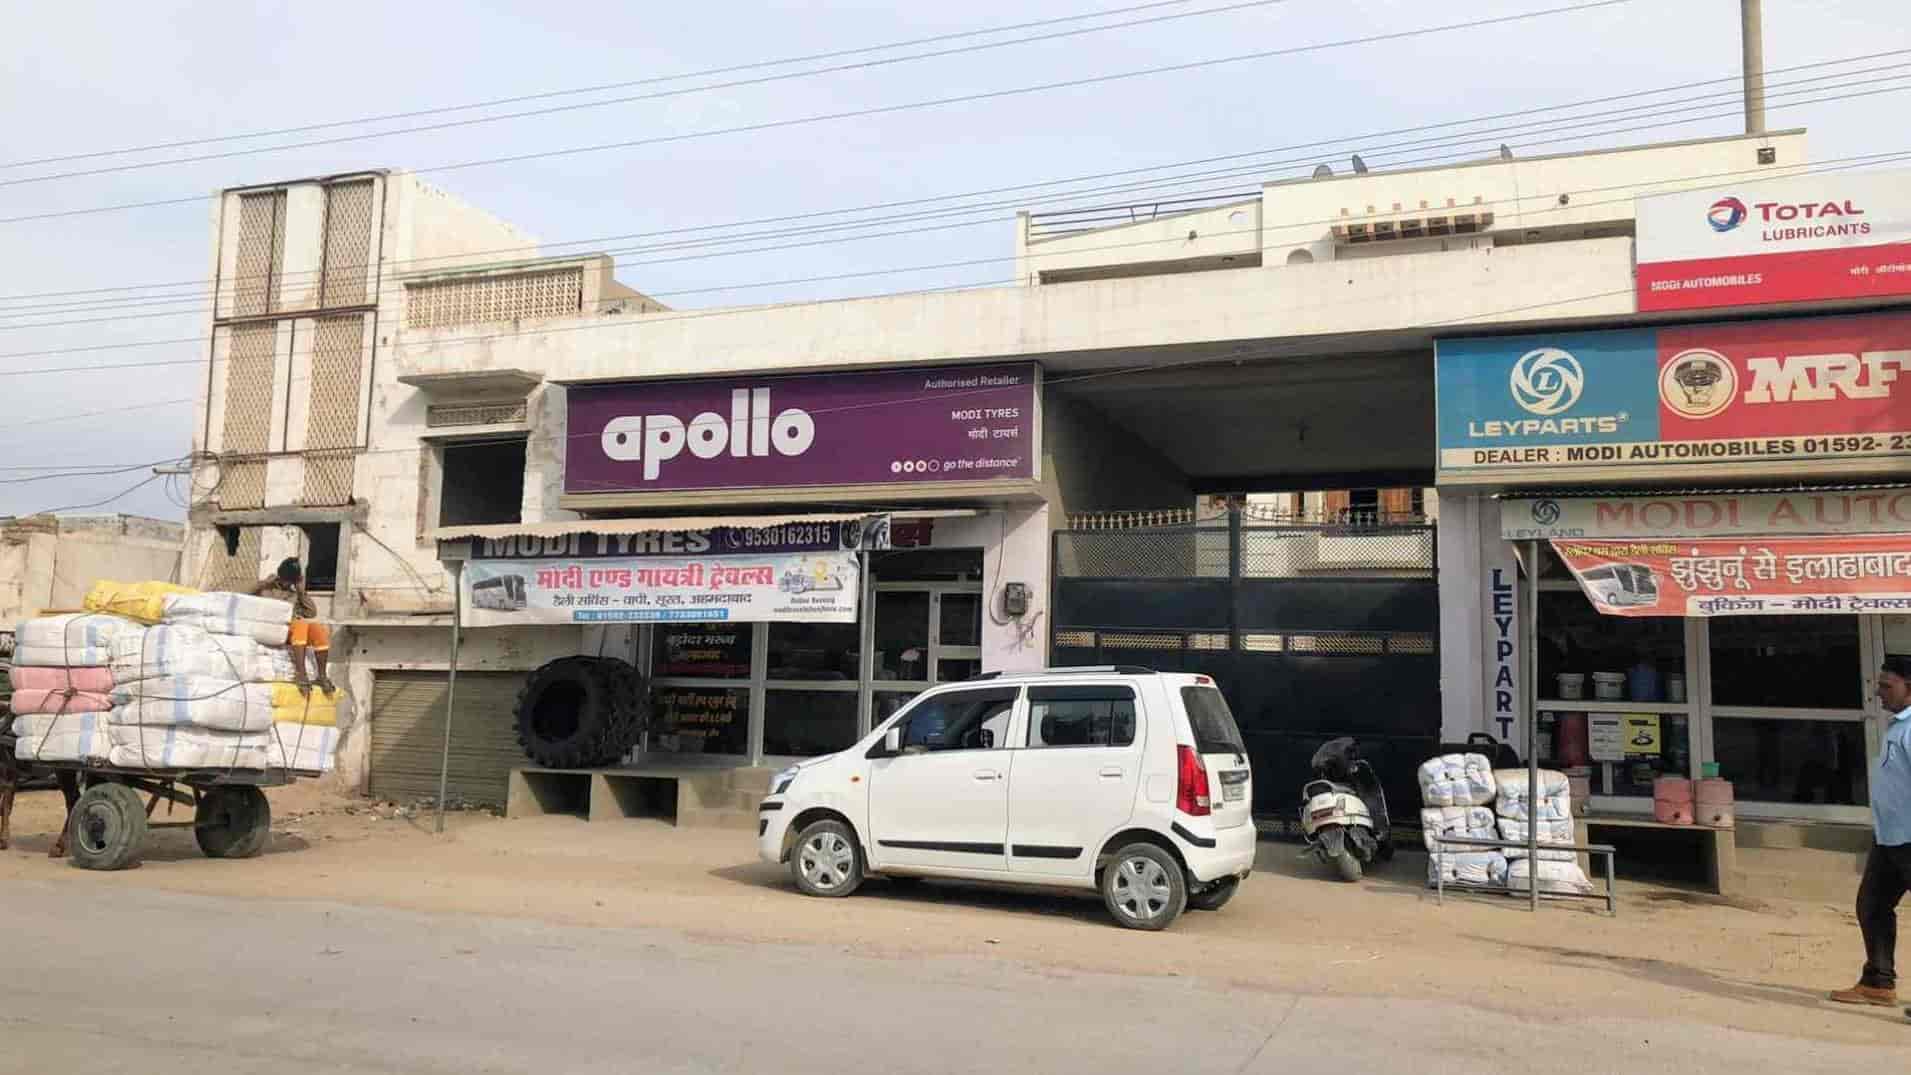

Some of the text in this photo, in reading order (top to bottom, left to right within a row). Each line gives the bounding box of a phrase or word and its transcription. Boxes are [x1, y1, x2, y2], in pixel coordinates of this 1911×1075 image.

[1755, 200, 1864, 222] TOTAL
[1763, 223, 1871, 241] LUBRICANTS
[1683, 274, 1762, 289] AUTOMOBILES
[924, 375, 1019, 390] Authorised Retailer
[1744, 350, 1911, 404] MRF
[951, 408, 1019, 420] MODI TYRES
[601, 387, 815, 480] apollo
[1474, 449, 1549, 464] DEALER
[1567, 445, 1622, 461] MODI
[1629, 439, 1796, 460] AUTOMOBILES
[1803, 437, 1883, 453] 01592-
[943, 457, 1018, 471] go the distance
[1596, 498, 1742, 529] MODI
[744, 525, 831, 547] 9530162315
[1506, 528, 1585, 538] LEYLAND
[536, 562, 775, 590] मोदी एण्ड गायत्री ट्रेवल्स
[1751, 547, 1777, 580] से
[1784, 551, 1911, 584] इलाहाबाद
[1698, 597, 1763, 616] बुकिंग
[1791, 595, 1842, 611] मोदी
